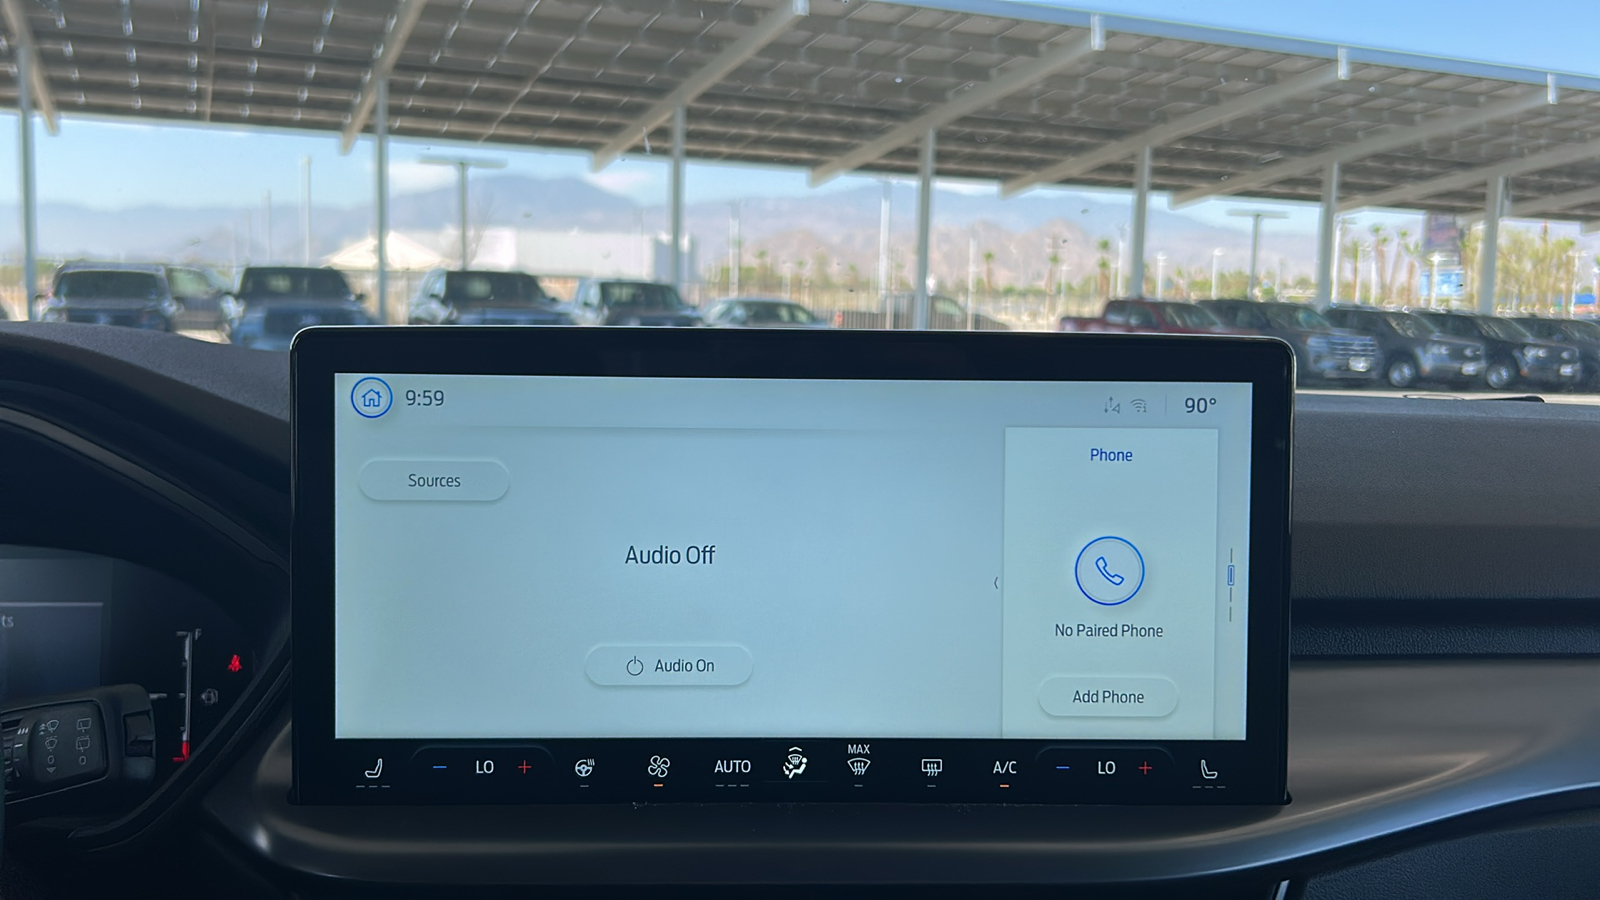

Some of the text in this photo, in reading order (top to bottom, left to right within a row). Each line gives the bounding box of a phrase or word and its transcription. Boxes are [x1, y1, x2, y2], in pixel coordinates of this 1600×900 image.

[405, 389, 445, 407] 9:59
[1184, 397, 1217, 414] 90°
[1090, 447, 1133, 462] Phone
[408, 473, 461, 488] Sources
[624, 544, 716, 565] Audio Off
[1055, 622, 1164, 638] No Paired Phone
[654, 658, 715, 673] Audio On
[1072, 689, 1145, 704] Add Phone
[847, 743, 871, 755] MAX
[475, 760, 494, 775] LO
[714, 760, 752, 774] AUTO
[992, 760, 1018, 775] A/C
[1097, 760, 1116, 775] LO
